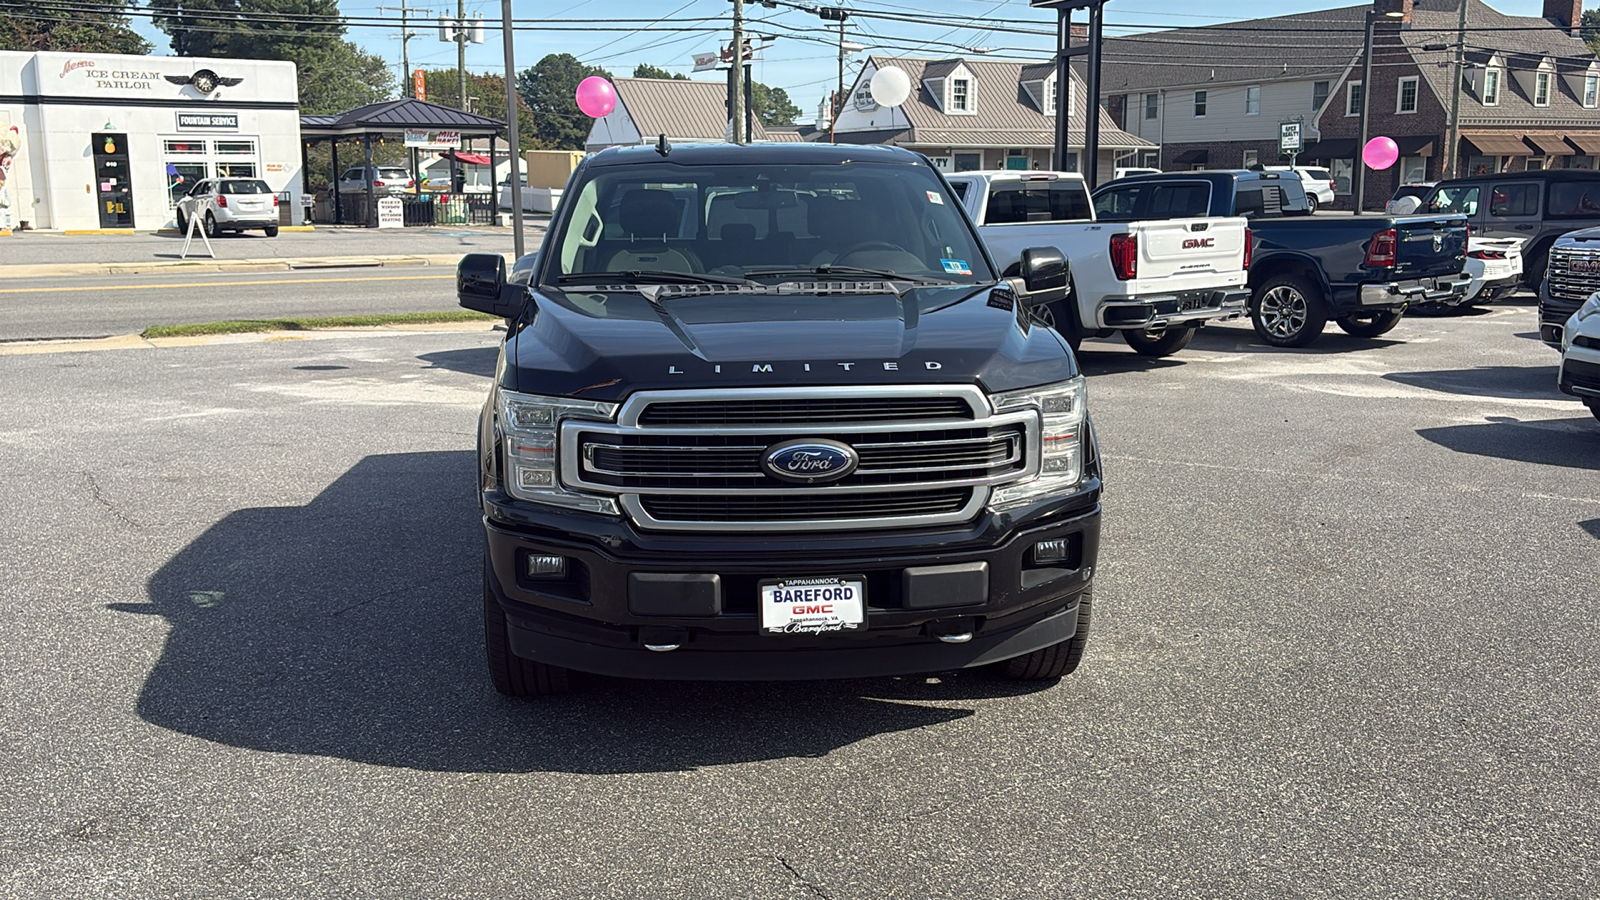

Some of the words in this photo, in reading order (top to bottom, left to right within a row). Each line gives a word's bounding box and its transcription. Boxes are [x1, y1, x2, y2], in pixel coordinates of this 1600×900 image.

[87, 70, 109, 79] ICE
[112, 70, 161, 80] CREAM
[96, 80, 152, 90] PARLOR
[180, 116, 210, 125] FOUNTAIN
[211, 117, 237, 126] SERVICE
[1182, 238, 1215, 249] GMC
[669, 361, 943, 375] LIMITED
[787, 451, 832, 471] Ford
[785, 577, 840, 586] TAPPAHANNOCK
[773, 587, 853, 603] BAREFORD
[792, 604, 834, 615] GMC
[784, 620, 844, 636] Bareford
